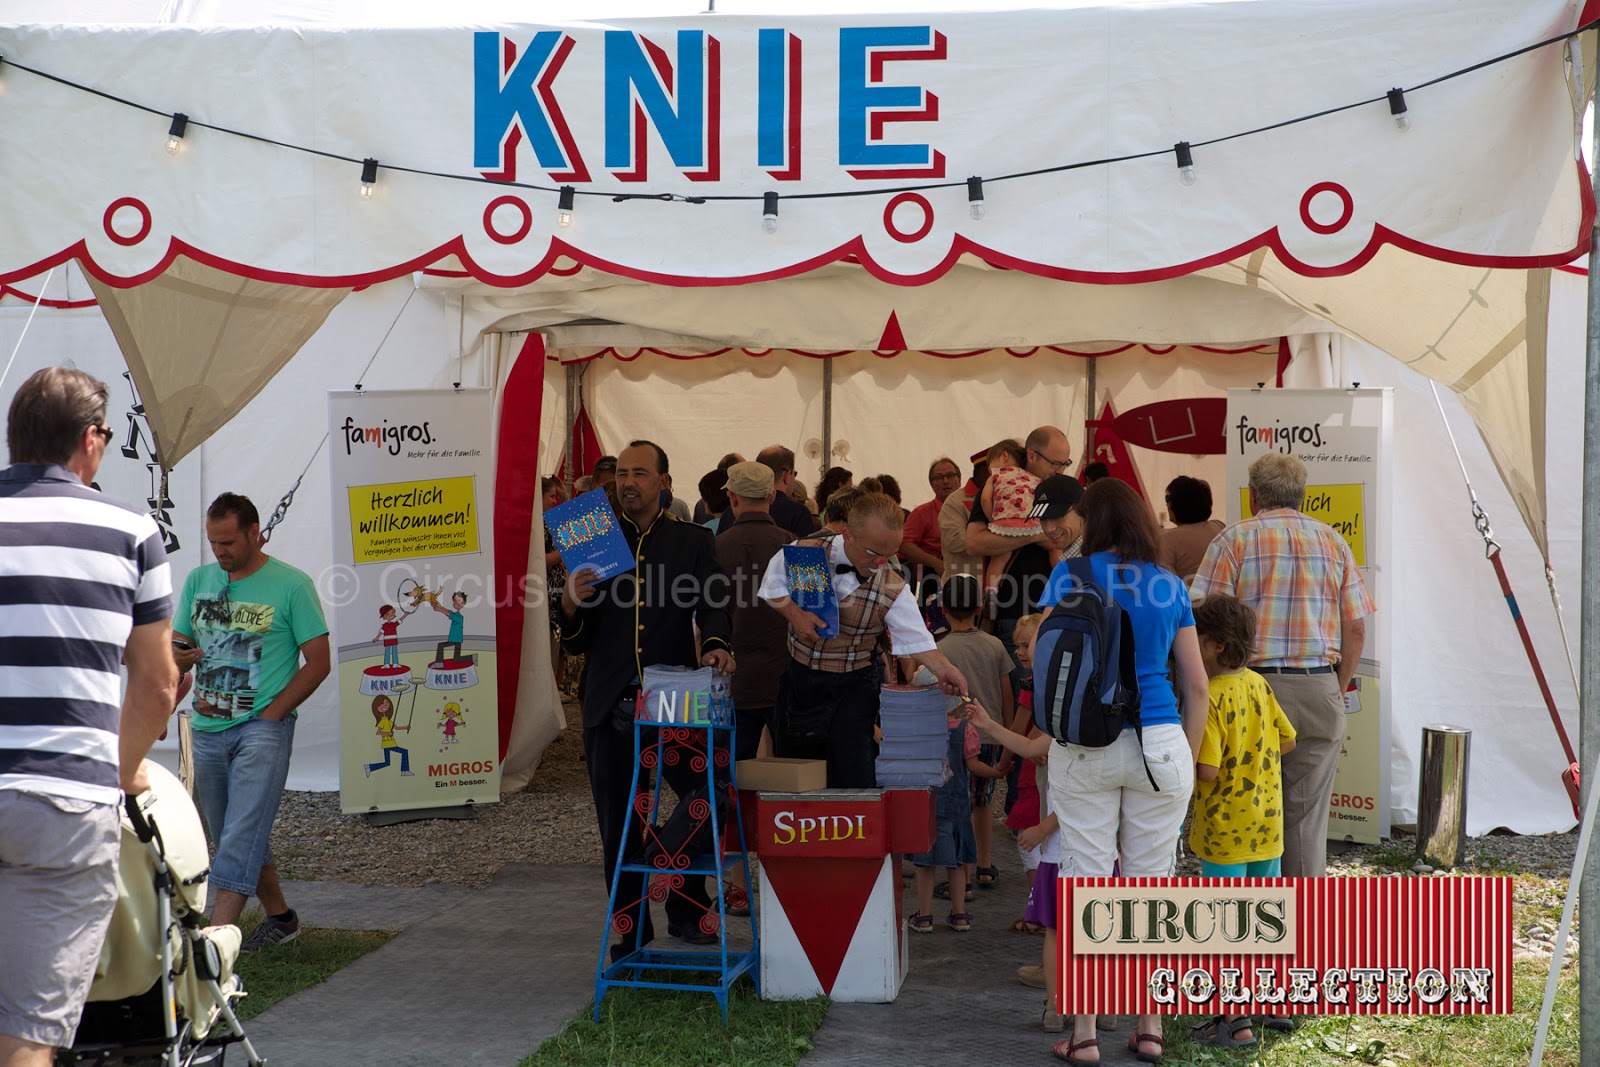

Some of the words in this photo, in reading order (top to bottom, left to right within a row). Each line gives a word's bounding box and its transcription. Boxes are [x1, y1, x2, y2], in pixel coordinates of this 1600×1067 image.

[473, 26, 948, 182] KNIE
[341, 416, 437, 456] famigros.
[407, 450, 426, 459] Mehr
[427, 449, 440, 459] für
[441, 449, 453, 458] die
[454, 448, 483, 458] Familie.
[1316, 453, 1329, 463] für
[1331, 453, 1343, 463] die
[371, 486, 443, 511] Herzlich
[359, 502, 471, 534] willkommen!
[370, 536, 402, 547] Famigros
[403, 533, 432, 544] wünscht
[454, 529, 466, 539] viel
[363, 546, 401, 558] Vergnügen
[402, 544, 414, 553] bei
[415, 542, 427, 552] der
[235, 610, 264, 626] OLIVE
[434, 672, 468, 685] KNIE
[634, 688, 711, 725] KNIE
[428, 760, 493, 777] MIGROS
[435, 780, 448, 788] Ein
[450, 779, 457, 788] M
[458, 778, 488, 786] besser.
[1330, 793, 1375, 811] GROS
[1338, 812, 1368, 823] besser.
